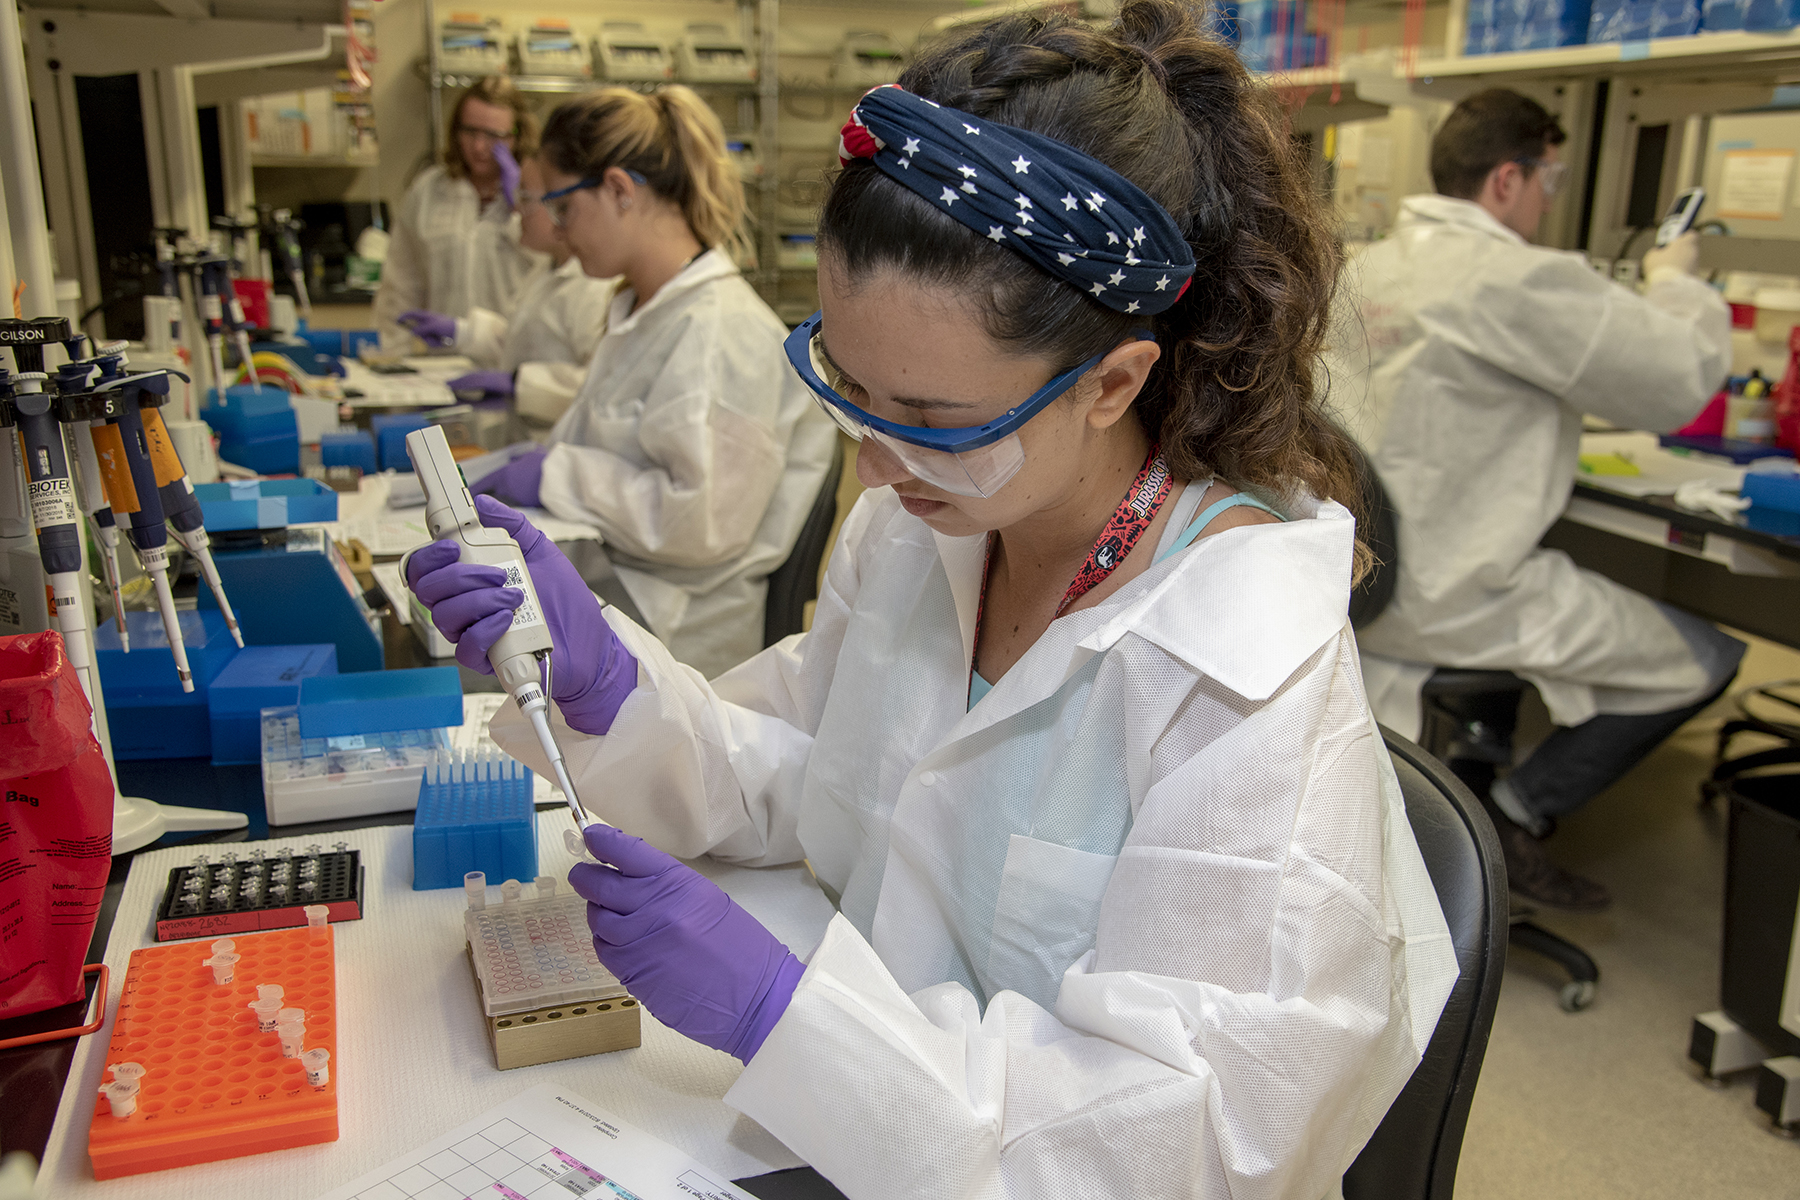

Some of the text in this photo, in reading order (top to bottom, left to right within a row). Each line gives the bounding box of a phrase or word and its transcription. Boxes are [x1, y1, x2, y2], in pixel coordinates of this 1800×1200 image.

[0, 329, 45, 341] GILSON
[105, 400, 114, 414] 5
[1130, 467, 1167, 518] JURASSIC
[5, 790, 39, 807] Bag
